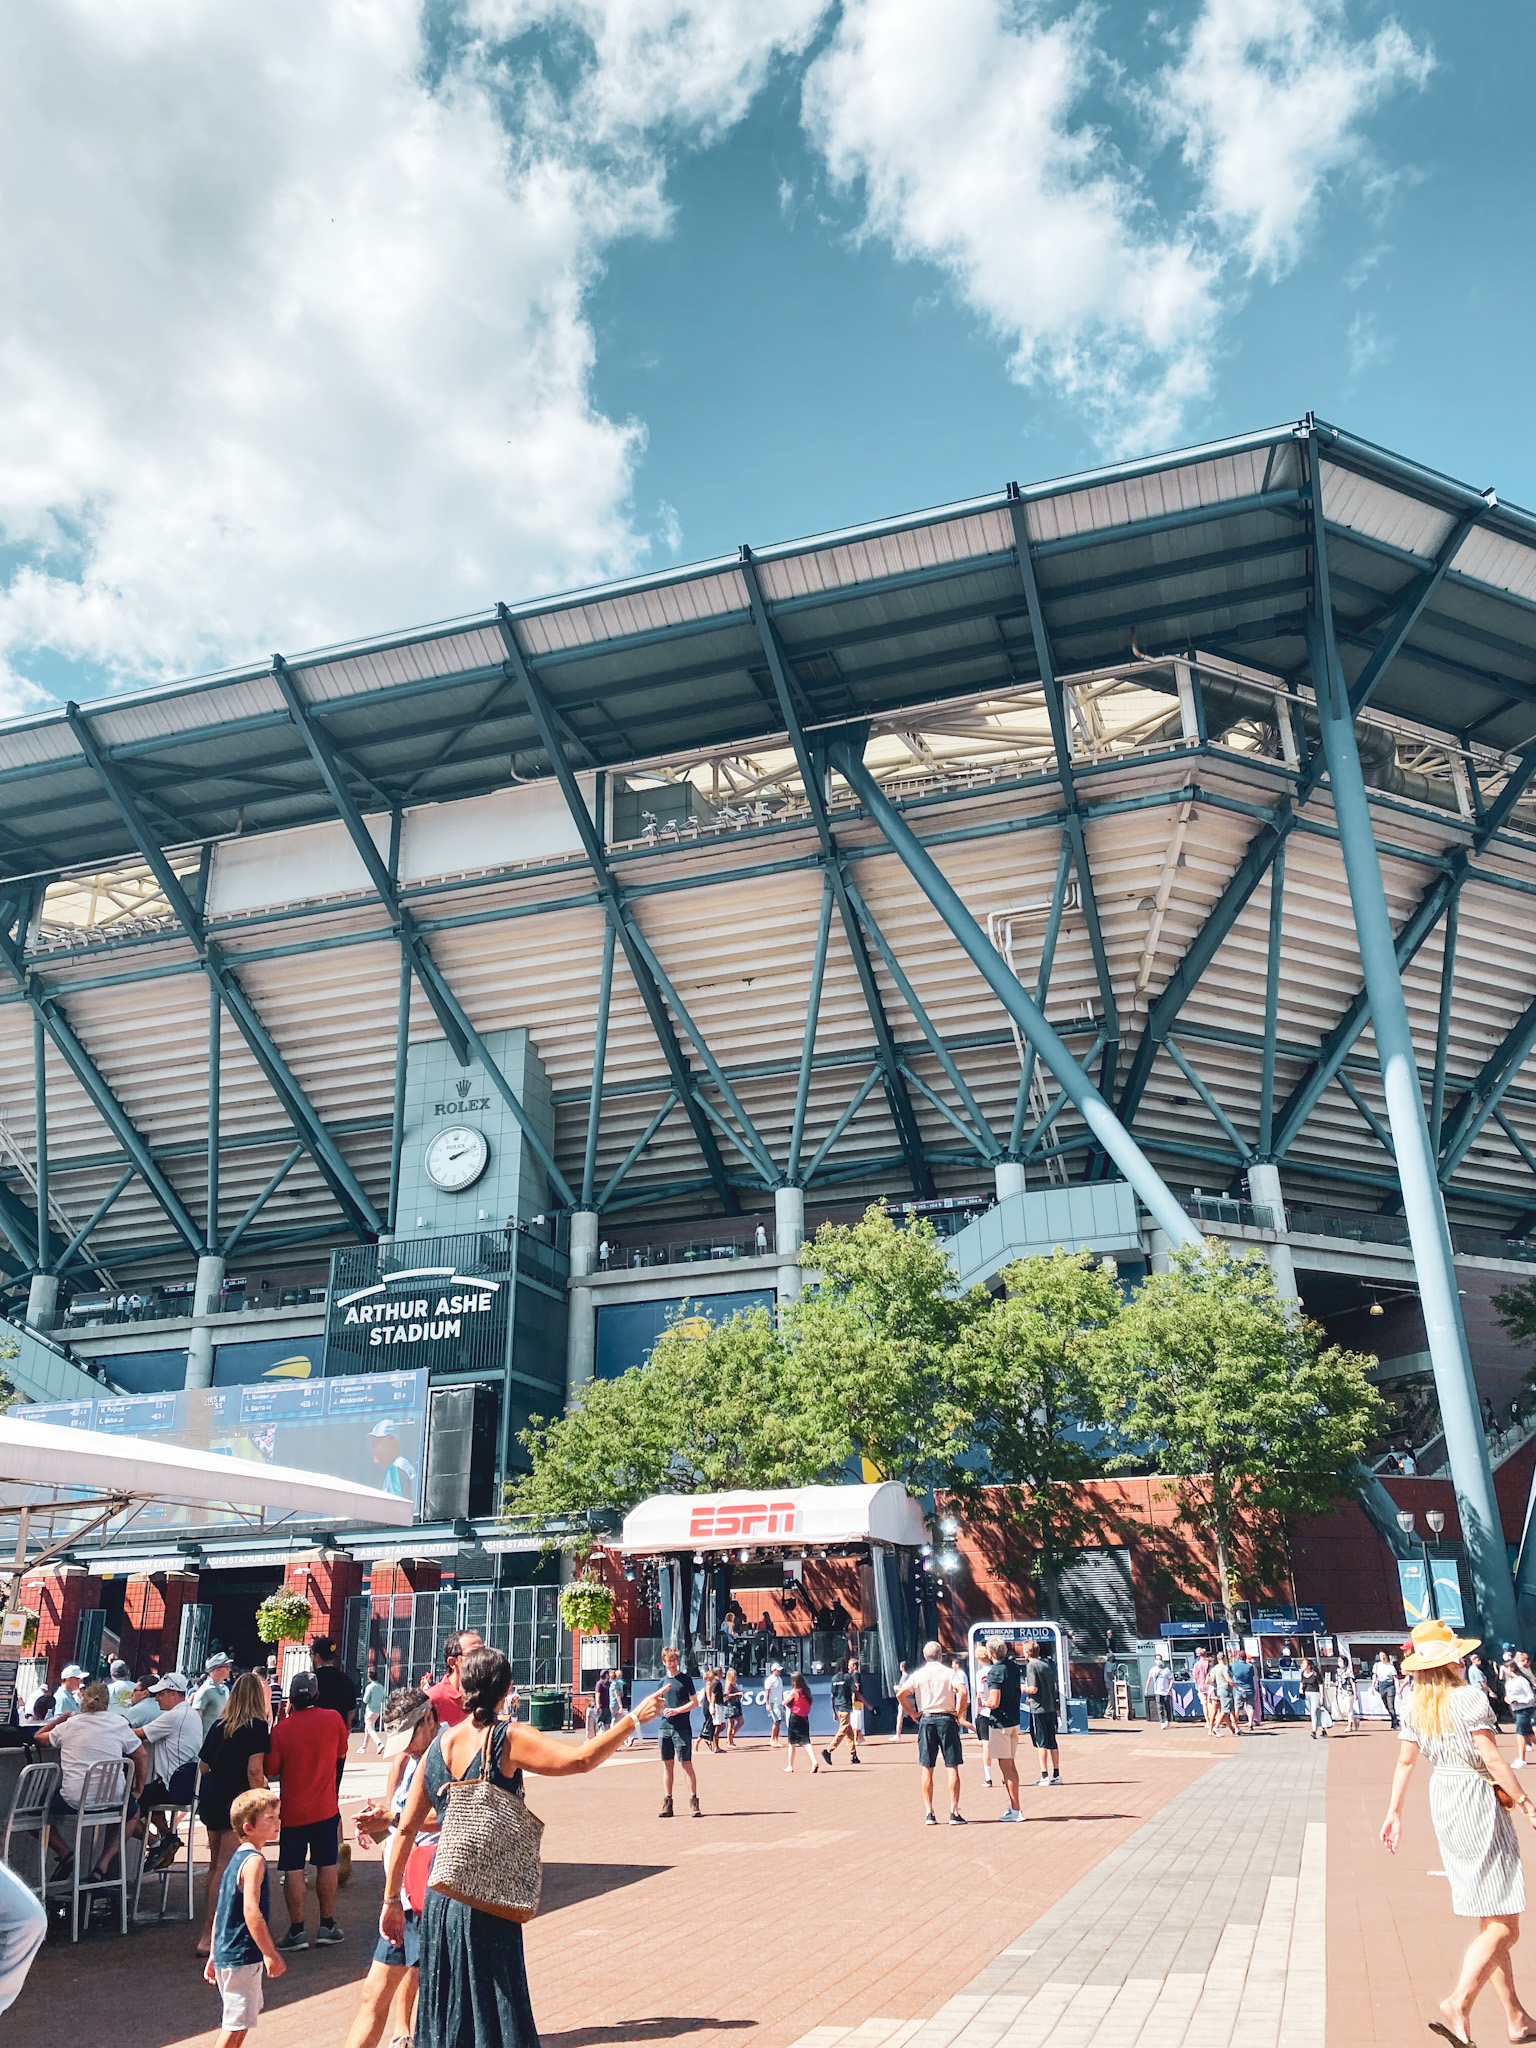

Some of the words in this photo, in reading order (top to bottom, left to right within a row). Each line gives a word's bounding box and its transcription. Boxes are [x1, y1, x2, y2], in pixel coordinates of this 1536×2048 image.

[434, 1097, 491, 1116] ROLEX
[446, 1143, 466, 1151] ROLEX
[343, 1299, 429, 1325] ARTHUR
[434, 1292, 492, 1316] ASHE
[369, 1319, 462, 1346] STADIUM
[689, 1502, 796, 1538] ESPN
[360, 1547, 383, 1557] ASHE
[384, 1545, 422, 1556] STADIUM
[424, 1543, 453, 1554] ENTRY
[481, 1540, 504, 1551] ASHE
[506, 1537, 546, 1549] STADIUM
[95, 1562, 117, 1572] ASHE
[117, 1559, 152, 1571] STADIUM
[153, 1557, 181, 1568] ENTRY
[205, 1556, 227, 1566] ASHE
[228, 1554, 265, 1565] STADIUM
[1019, 1628, 1049, 1637] RADIO
